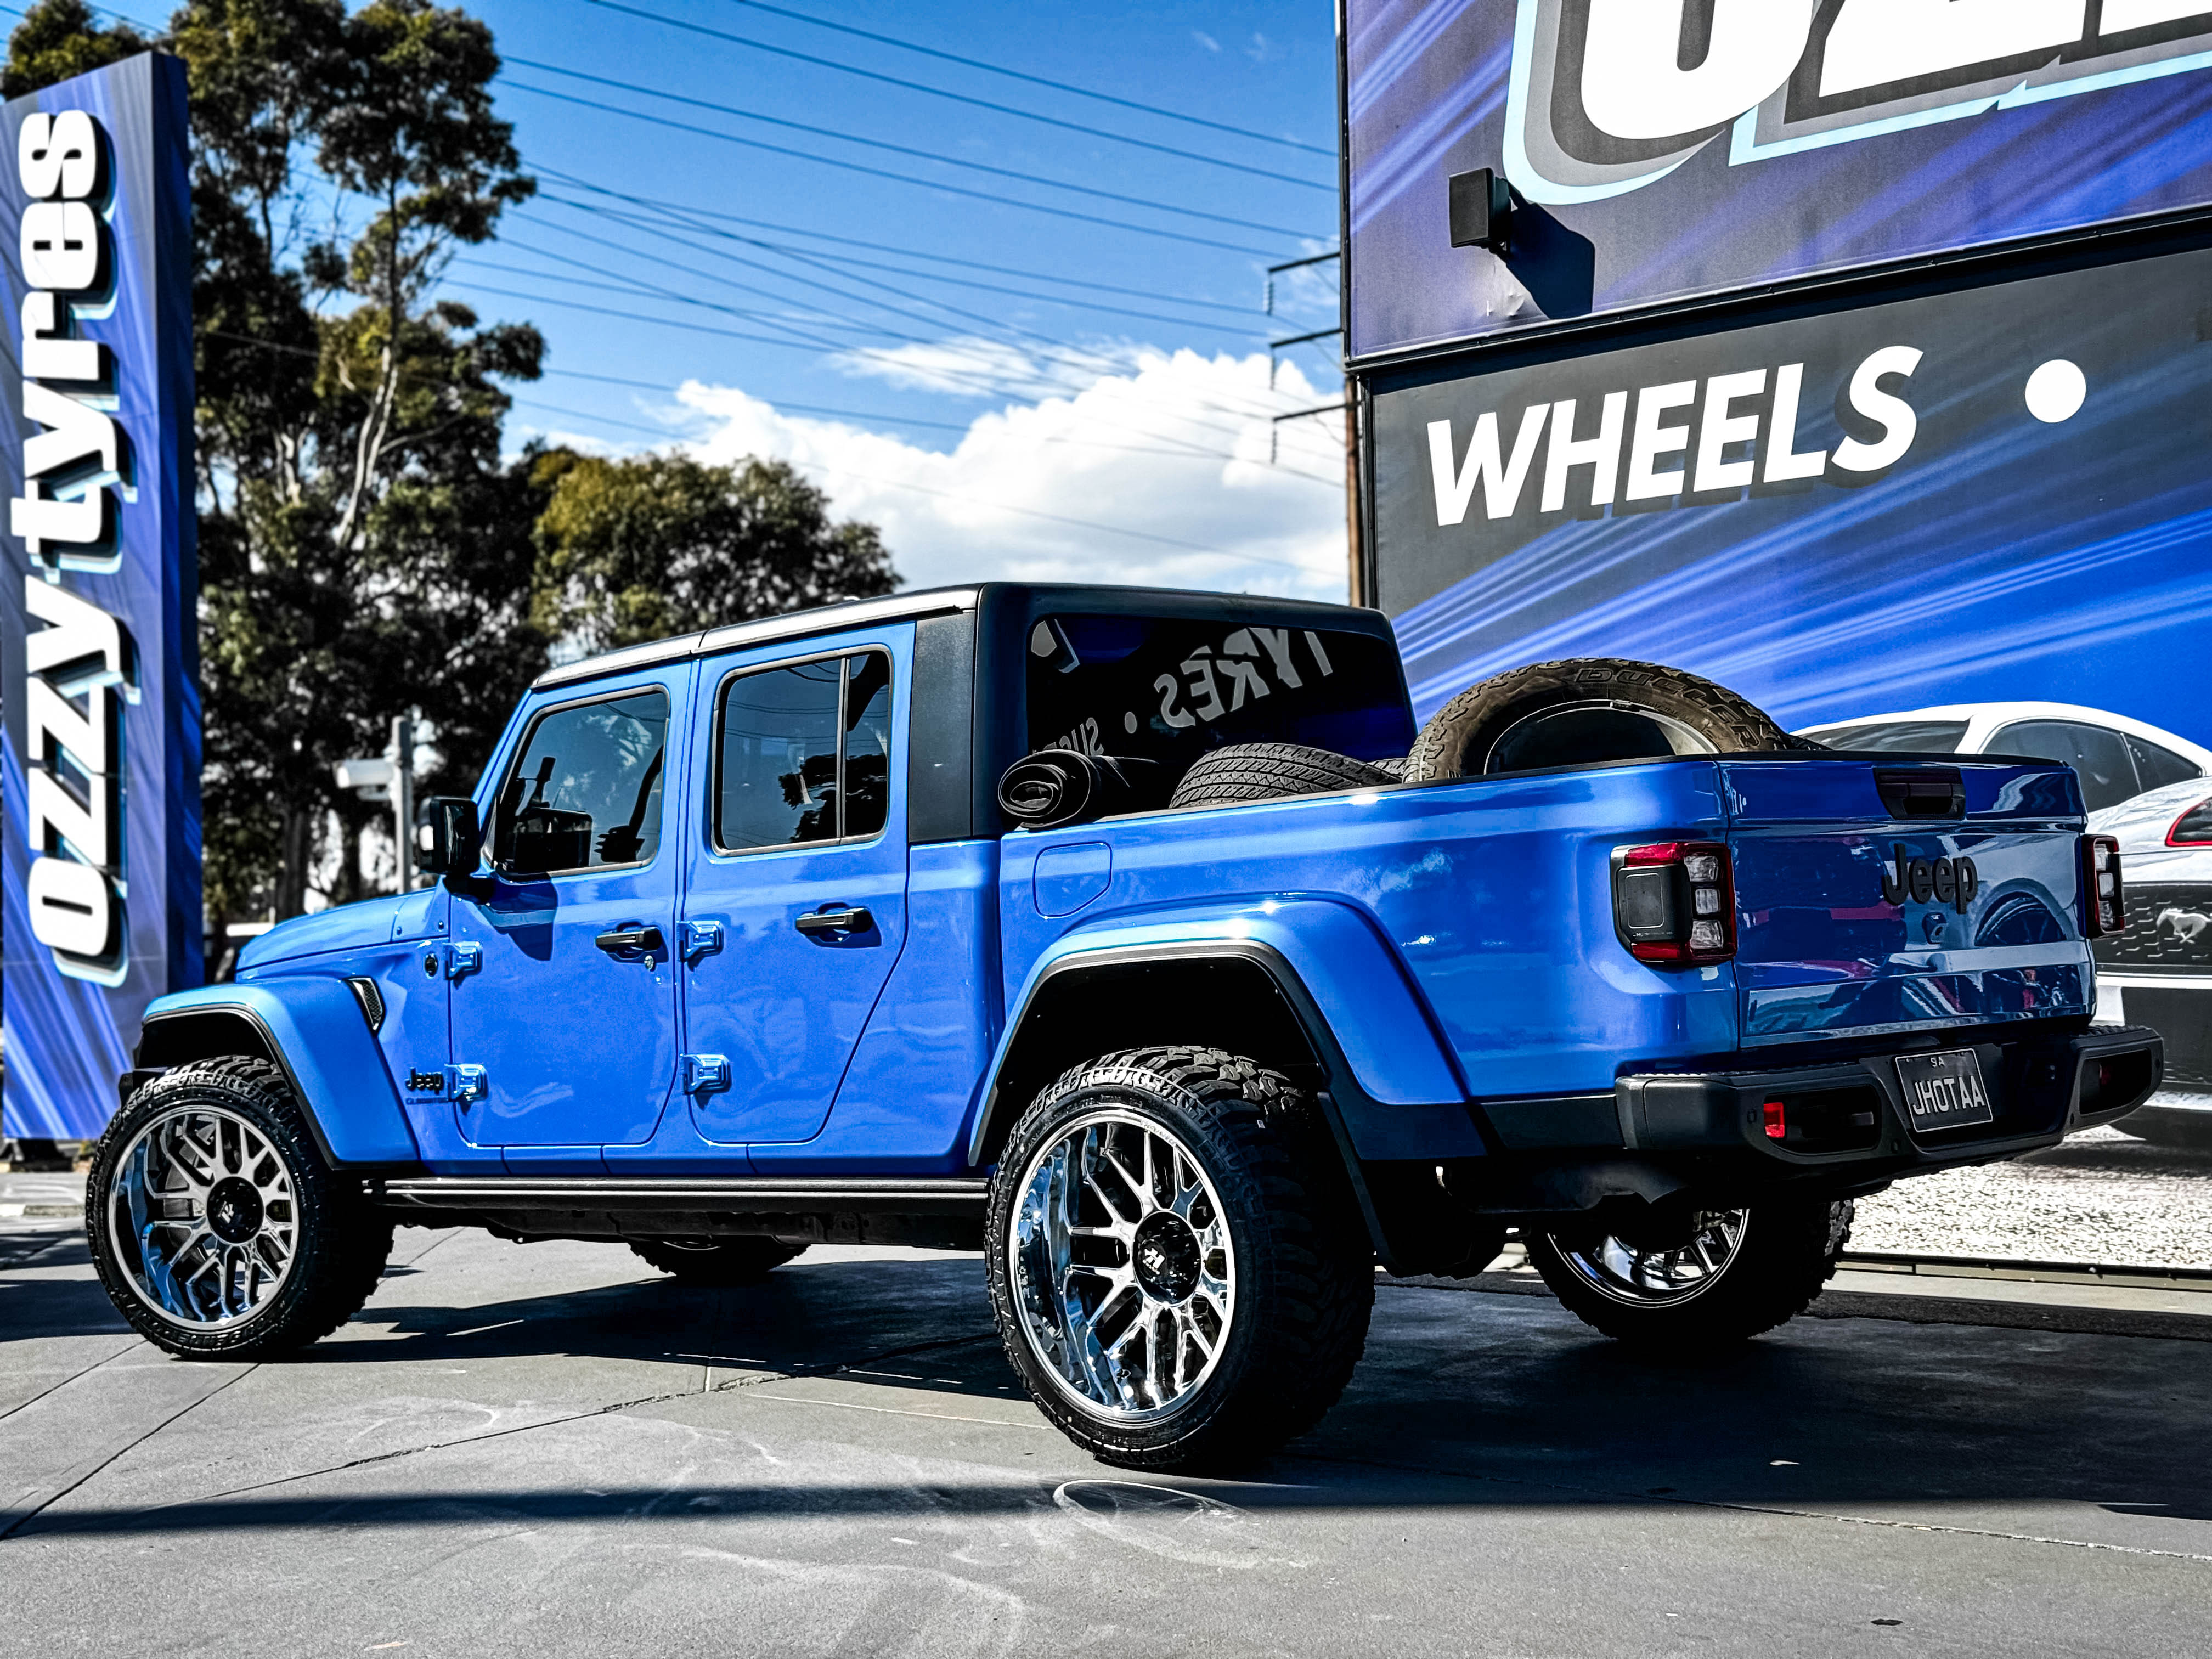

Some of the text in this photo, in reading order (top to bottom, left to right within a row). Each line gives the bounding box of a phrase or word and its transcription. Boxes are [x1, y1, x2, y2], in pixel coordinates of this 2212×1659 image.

[1426, 344, 1923, 527] WHEELS
[1881, 843, 1978, 915] Jeep
[1930, 1057, 1945, 1068] SA
[1912, 1075, 1985, 1115] JHOTAA
